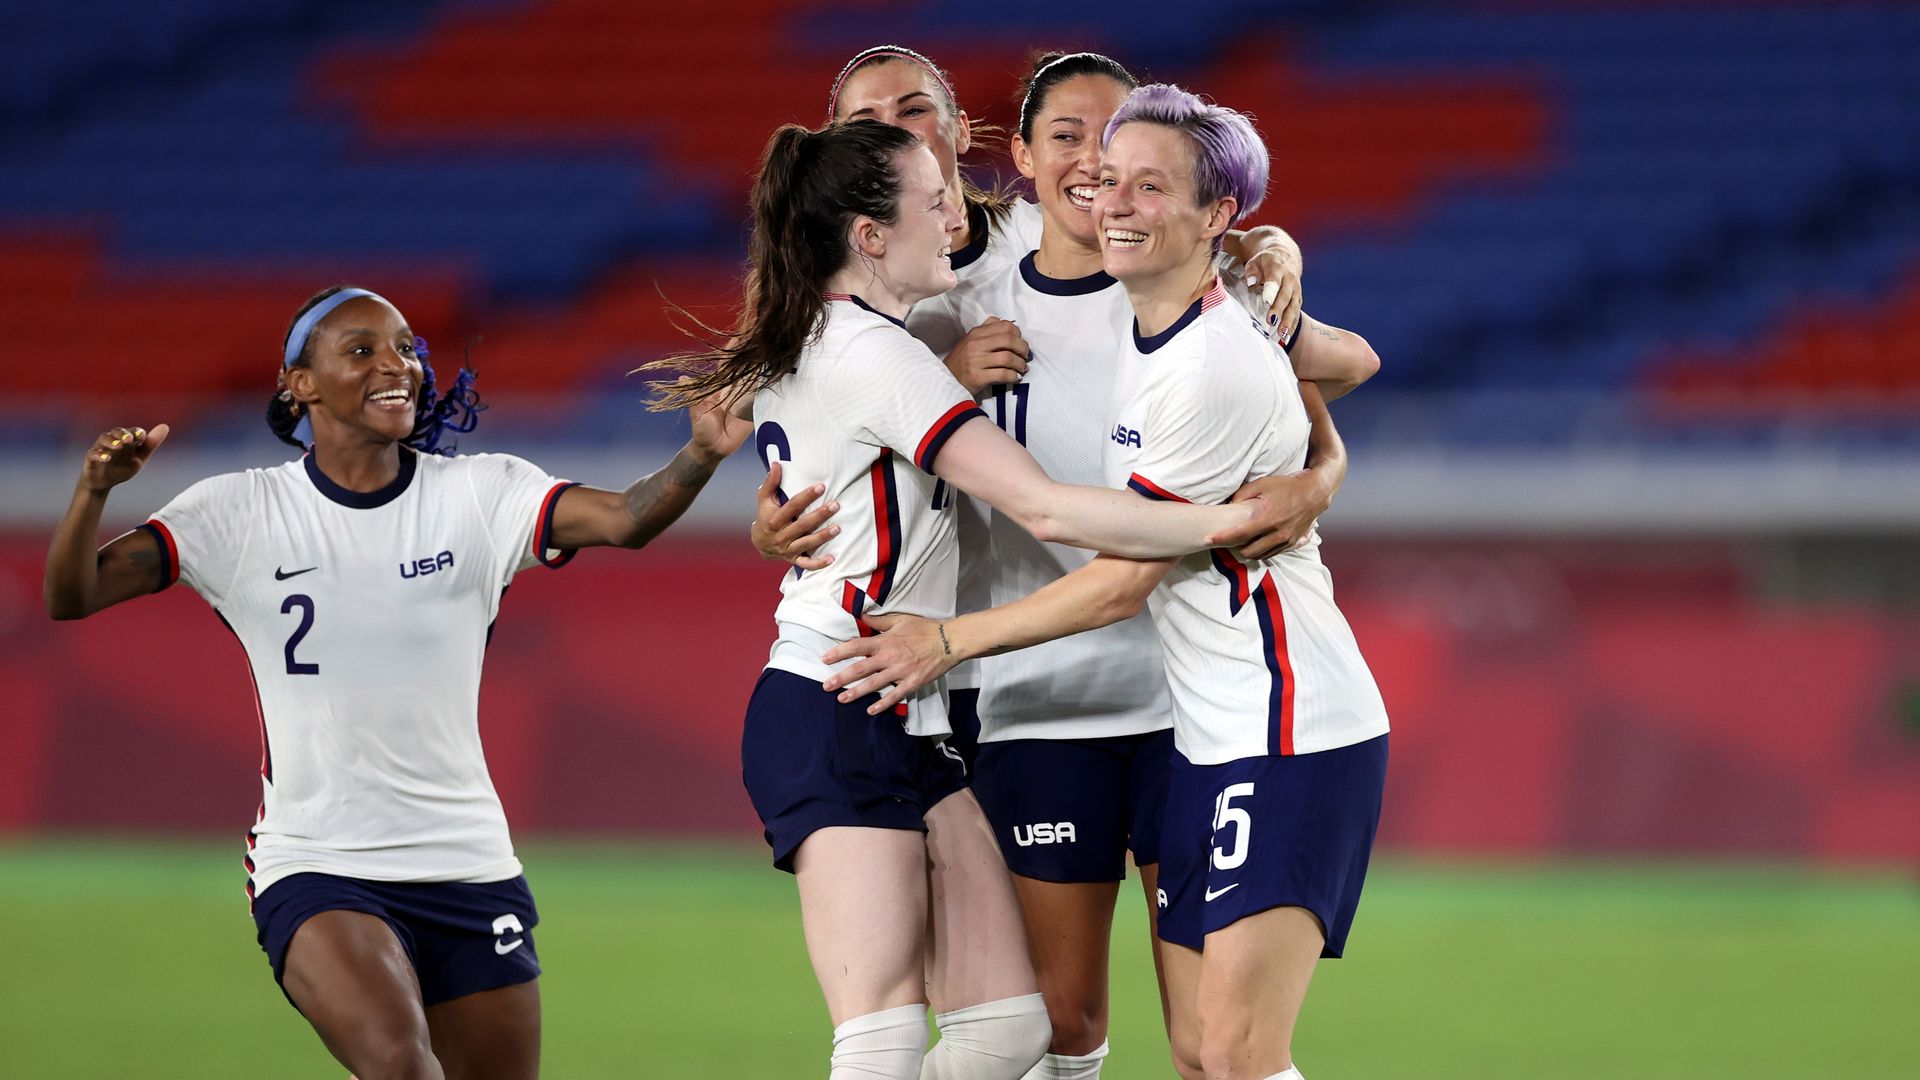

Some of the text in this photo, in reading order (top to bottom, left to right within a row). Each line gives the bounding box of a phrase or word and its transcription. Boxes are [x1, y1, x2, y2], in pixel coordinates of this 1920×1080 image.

[1111, 421, 1142, 449] USA
[400, 550, 454, 579] USA
[280, 594, 320, 675] 2
[1013, 821, 1076, 847] USA
[1209, 782, 1255, 872] 5
